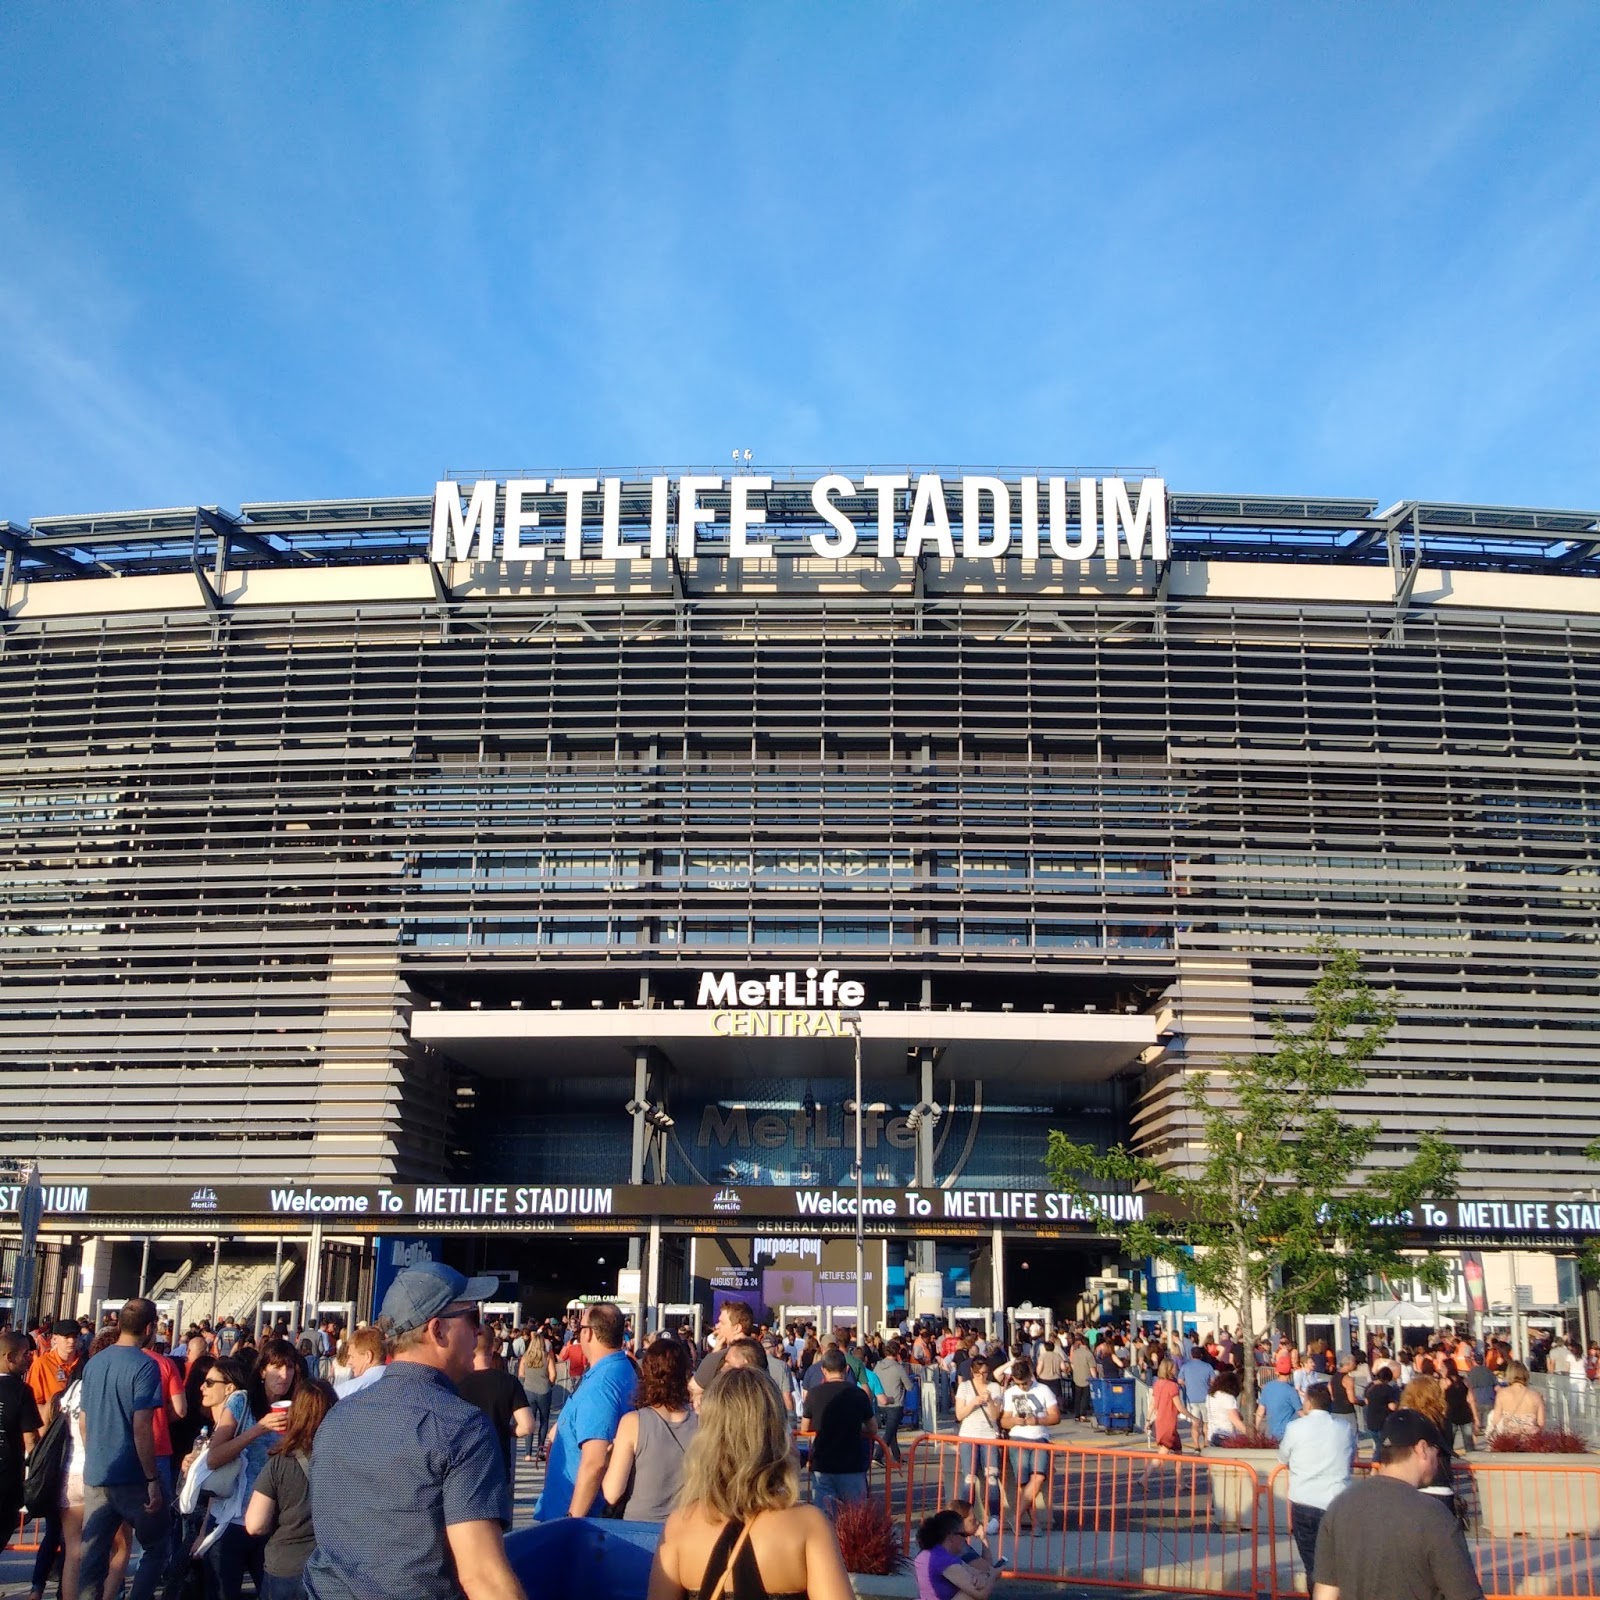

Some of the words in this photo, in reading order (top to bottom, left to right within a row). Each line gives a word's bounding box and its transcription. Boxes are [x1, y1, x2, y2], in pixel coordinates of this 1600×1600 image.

[430, 476, 776, 562] METLIFE
[808, 474, 1168, 561] STADIUM
[697, 967, 865, 1007] MetLife
[709, 1010, 853, 1037] CENTRAL
[697, 1099, 919, 1149] MetLife
[0, 1187, 88, 1211] STIUM
[271, 1189, 368, 1212] Welcome
[378, 1190, 403, 1212] To
[415, 1188, 507, 1213] METLIFE
[514, 1188, 613, 1213] STADIUM
[796, 1191, 897, 1215] Welcome
[905, 1193, 932, 1215] To
[943, 1191, 1038, 1218] METLIFE
[89, 1219, 145, 1229] GENERAL
[150, 1219, 220, 1229] ADMISSION
[417, 1219, 477, 1230] GENERAL
[482, 1220, 555, 1230] ADMISSION
[757, 1221, 818, 1232] GENERAL
[822, 1222, 896, 1233] ADMISION
[1421, 1204, 1448, 1226] To
[1458, 1203, 1549, 1229] METLIFE
[1439, 1234, 1499, 1245] GENERAL
[1503, 1235, 1575, 1246] ADMISSION
[710, 1278, 734, 1286] AUGUST
[735, 1278, 743, 1286] 23
[751, 1278, 758, 1286] 24
[819, 1271, 845, 1280] METLIFE
[845, 1271, 873, 1281] STAUM
